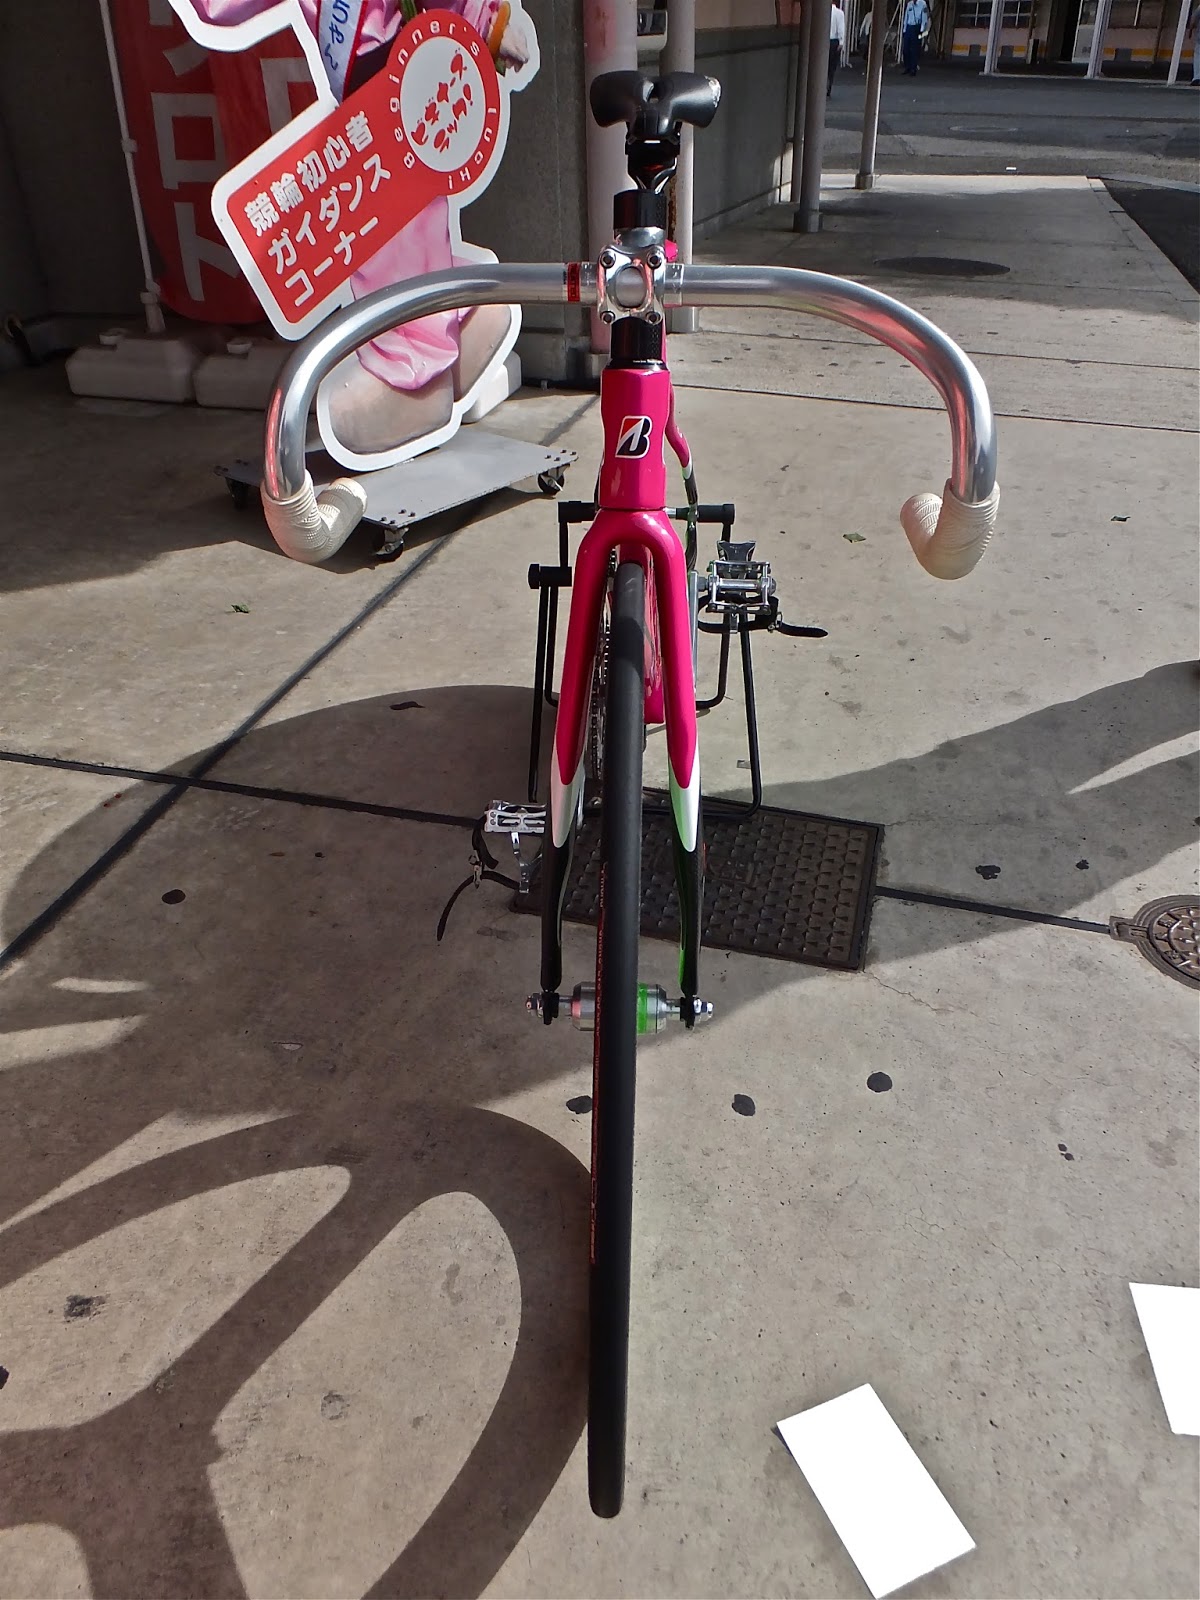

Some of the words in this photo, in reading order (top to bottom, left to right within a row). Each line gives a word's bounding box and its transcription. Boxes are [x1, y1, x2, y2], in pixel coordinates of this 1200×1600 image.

[389, 20, 480, 169] Beginner's
[244, 110, 374, 237] 競輪初心者
[268, 153, 391, 275] ガイダンス
[284, 216, 379, 307] コーナー
